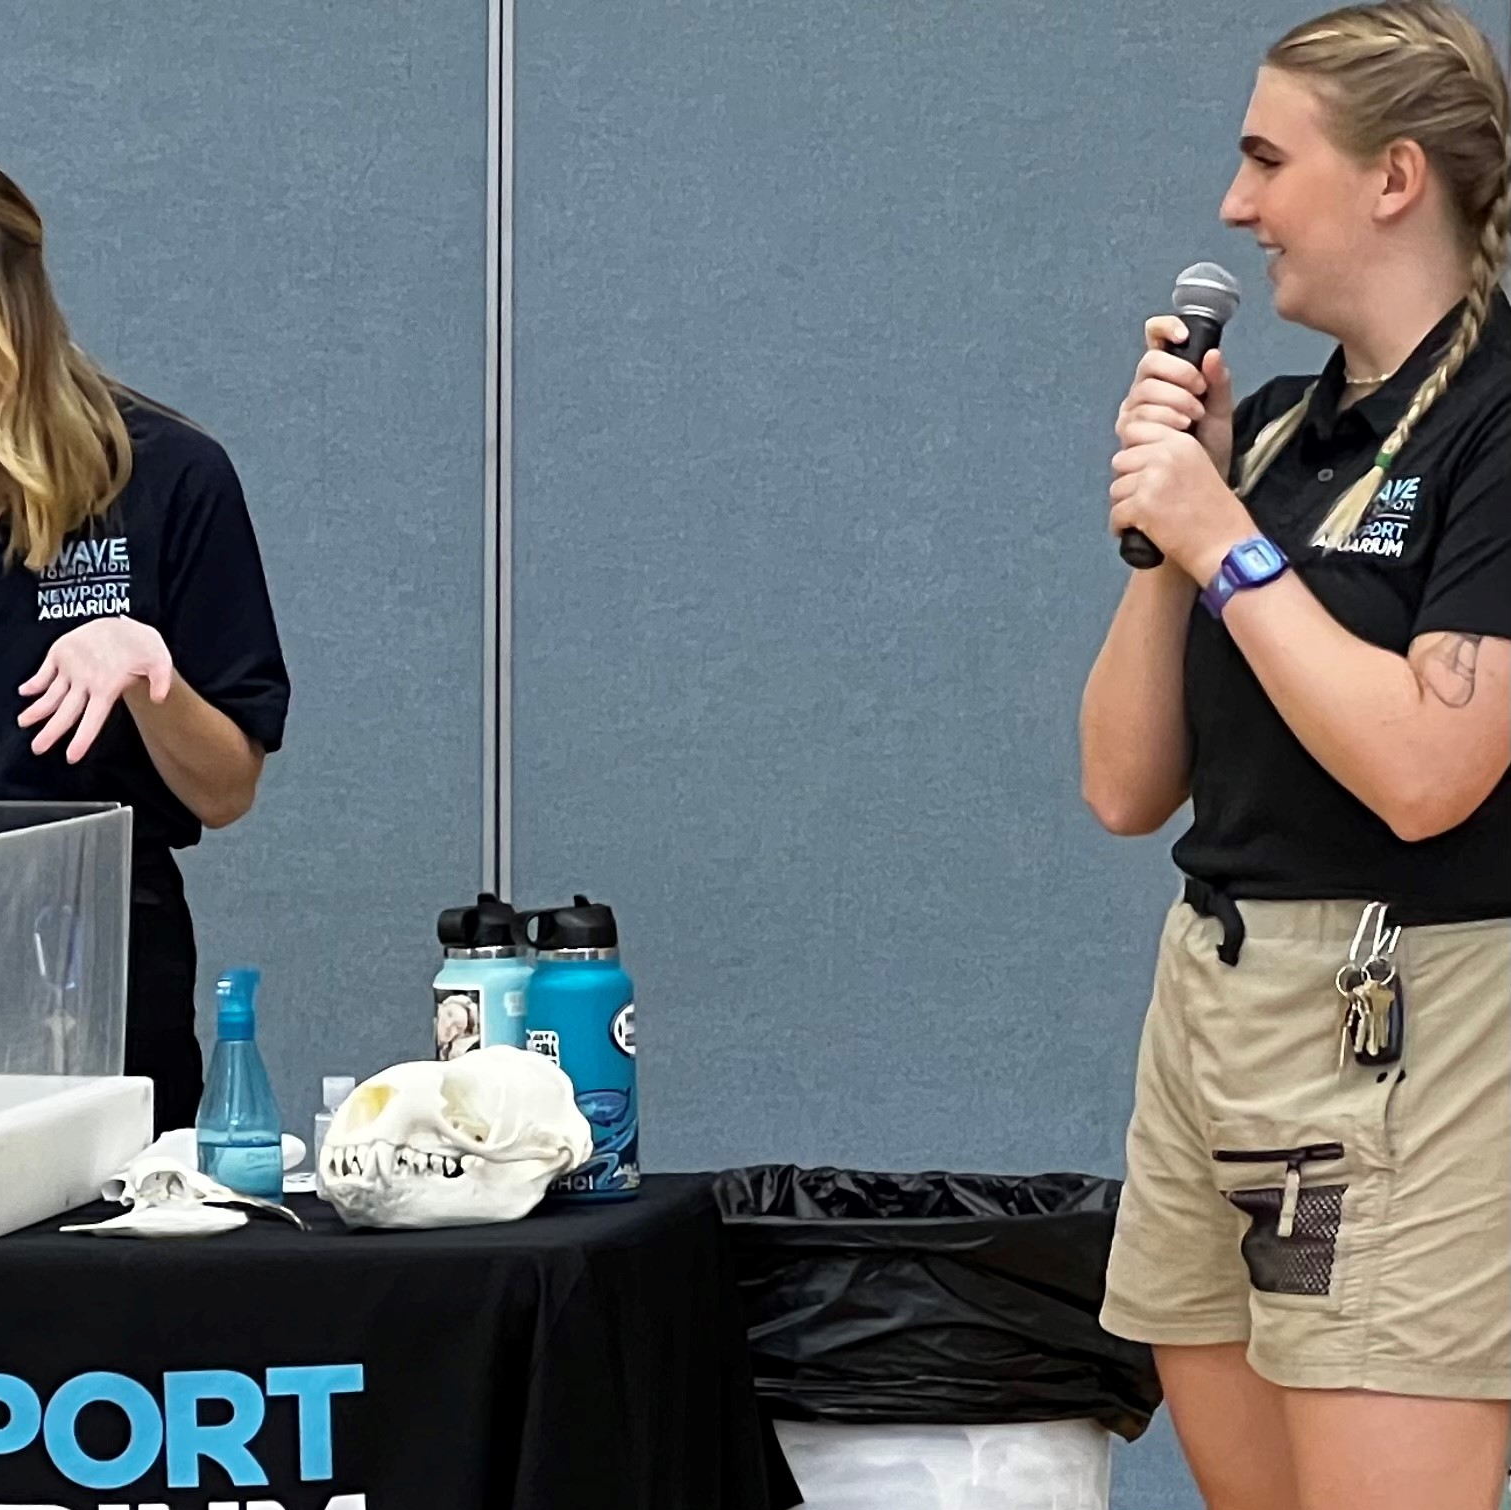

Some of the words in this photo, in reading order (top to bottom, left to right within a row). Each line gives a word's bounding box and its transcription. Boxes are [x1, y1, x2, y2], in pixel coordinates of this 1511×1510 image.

[1375, 477, 1421, 501] AVE
[37, 582, 130, 606] NEWPORT
[37, 597, 130, 621] AQUARIUM
[550, 1175, 594, 1191] HOI
